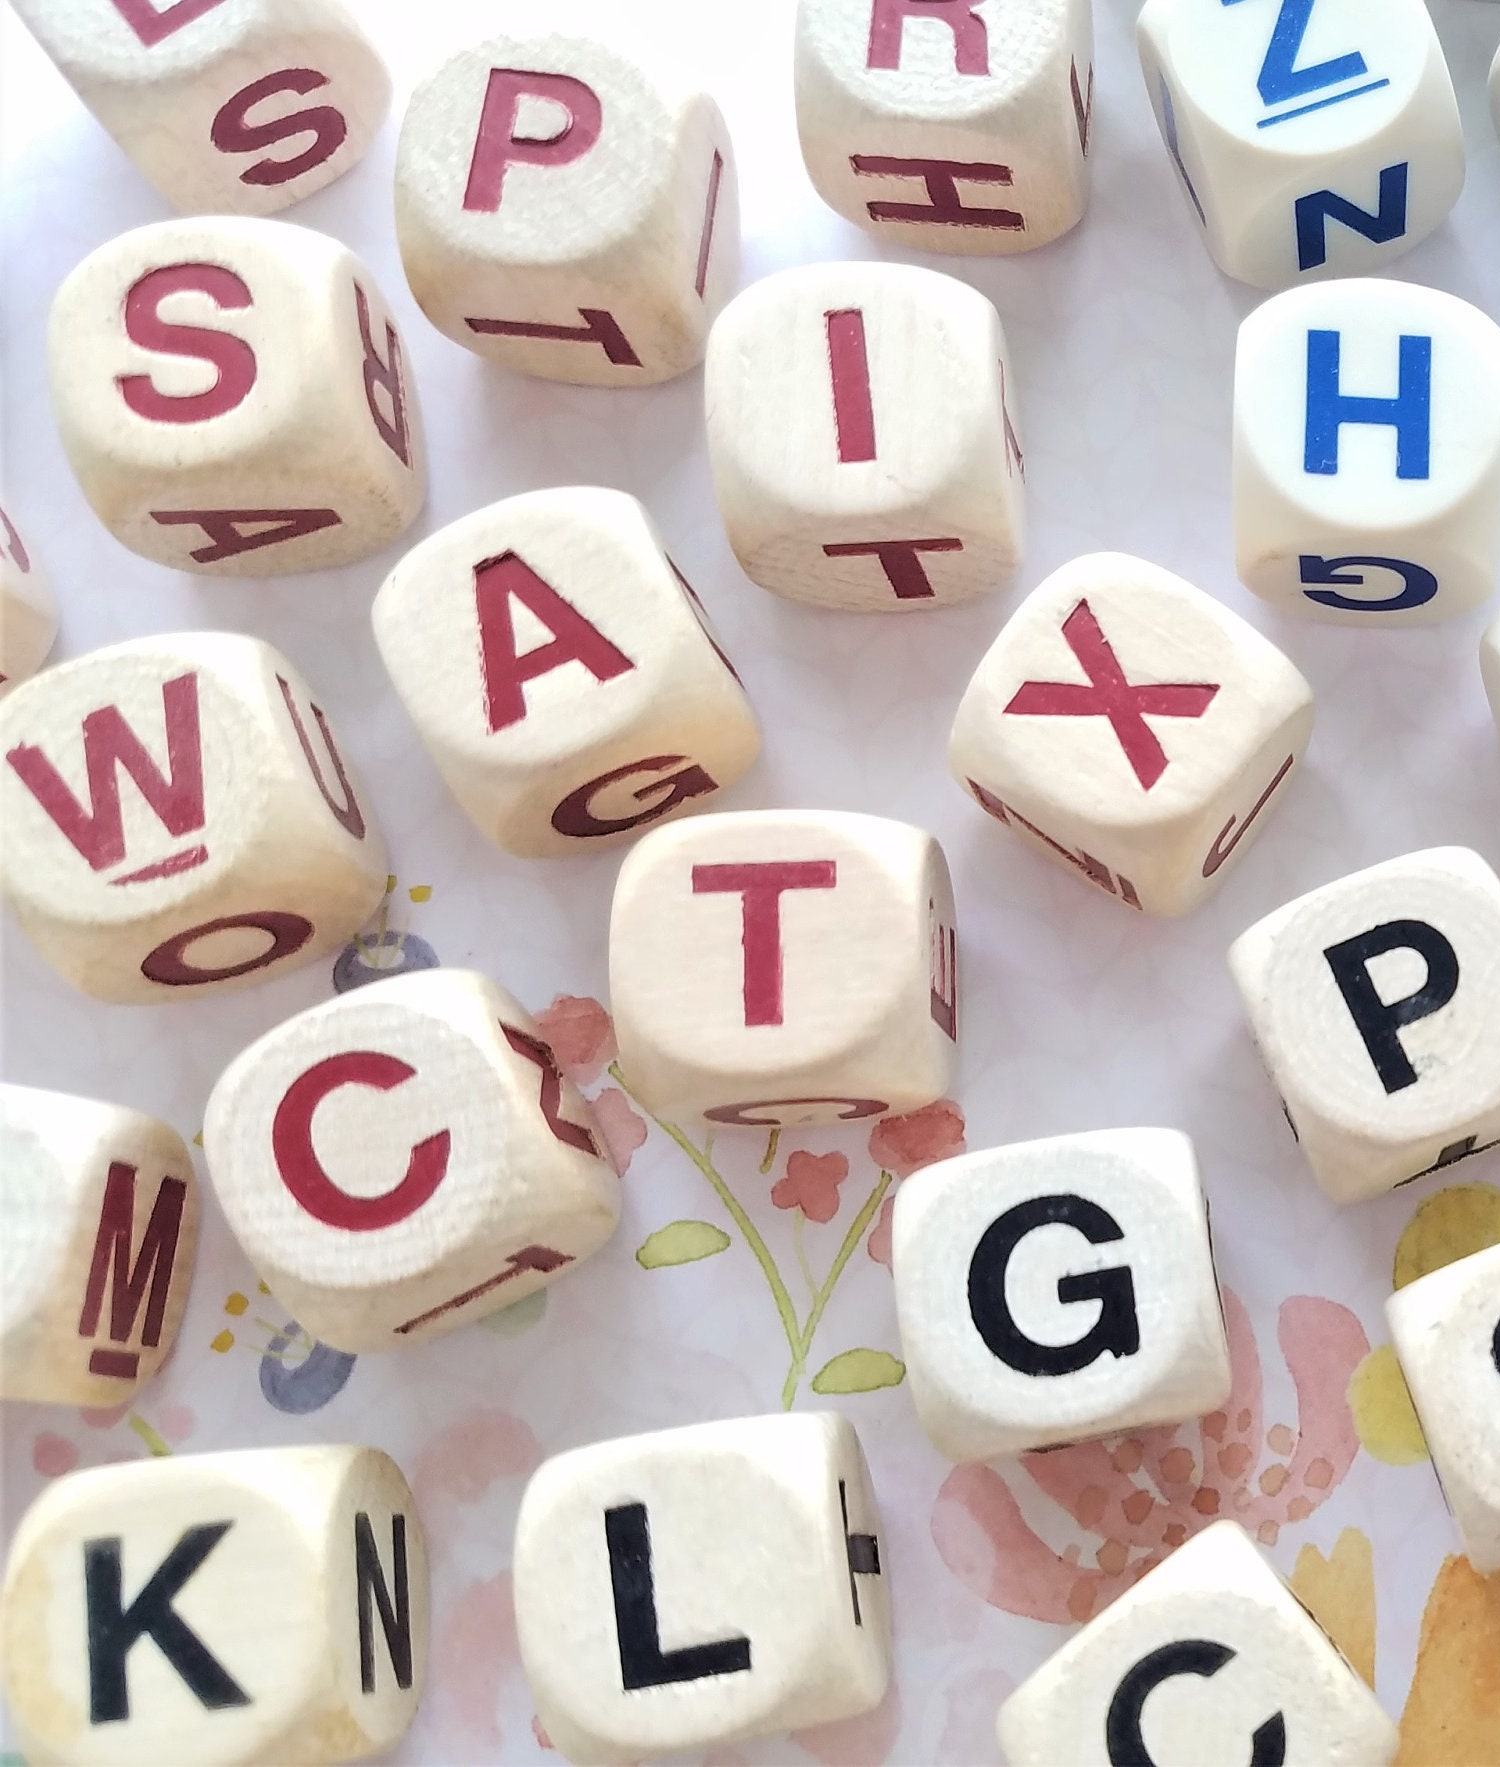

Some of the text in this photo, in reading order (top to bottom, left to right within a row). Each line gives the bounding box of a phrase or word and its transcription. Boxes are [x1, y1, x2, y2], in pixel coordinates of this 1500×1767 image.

[211, 68, 347, 186] S
[463, 68, 602, 212] P
[849, 155, 1025, 232] H
[115, 261, 257, 423] S
[823, 309, 876, 463] I
[1304, 330, 1431, 480] H
[150, 509, 342, 563] A
[822, 538, 962, 599] T
[1299, 555, 1438, 611] G
[473, 549, 635, 733] A
[1003, 598, 1220, 791] X
[6, 673, 205, 871] W
[276, 674, 366, 842] U
[551, 755, 719, 837] G
[140, 911, 315, 986] O
[692, 860, 836, 1026] T
[1323, 919, 1459, 1094] P
[272, 1051, 450, 1232] C
[79, 1162, 188, 1353] M
[967, 1194, 1140, 1377] G
[85, 1522, 251, 1724] K
[355, 1513, 412, 1693] N
[604, 1503, 751, 1691] L
[1106, 1640, 1286, 1767] C
